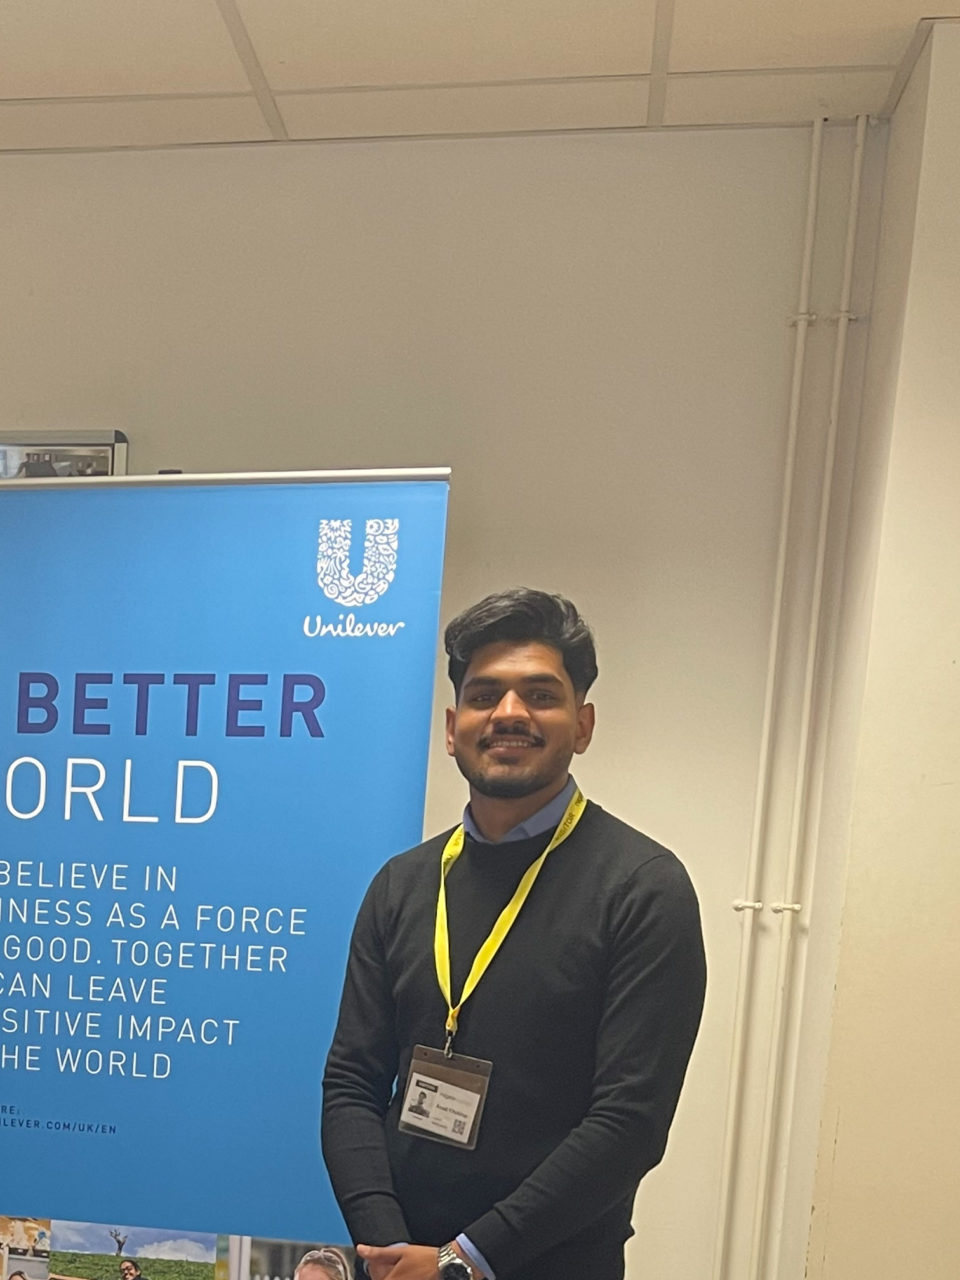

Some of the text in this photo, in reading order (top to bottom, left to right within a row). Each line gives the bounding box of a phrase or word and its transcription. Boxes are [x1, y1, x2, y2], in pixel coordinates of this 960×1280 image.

[303, 613, 405, 638] Unilever
[16, 672, 326, 738] BETTER
[144, 865, 178, 892] IN
[106, 903, 146, 929] AS
[161, 904, 180, 931] A
[196, 905, 308, 936] FORCE
[3, 936, 102, 966] GOOD.
[111, 939, 289, 973] TOGETHER
[68, 974, 168, 1005] LEAVE
[118, 1014, 240, 1046] IMPACT
[56, 1047, 173, 1079] WORLD
